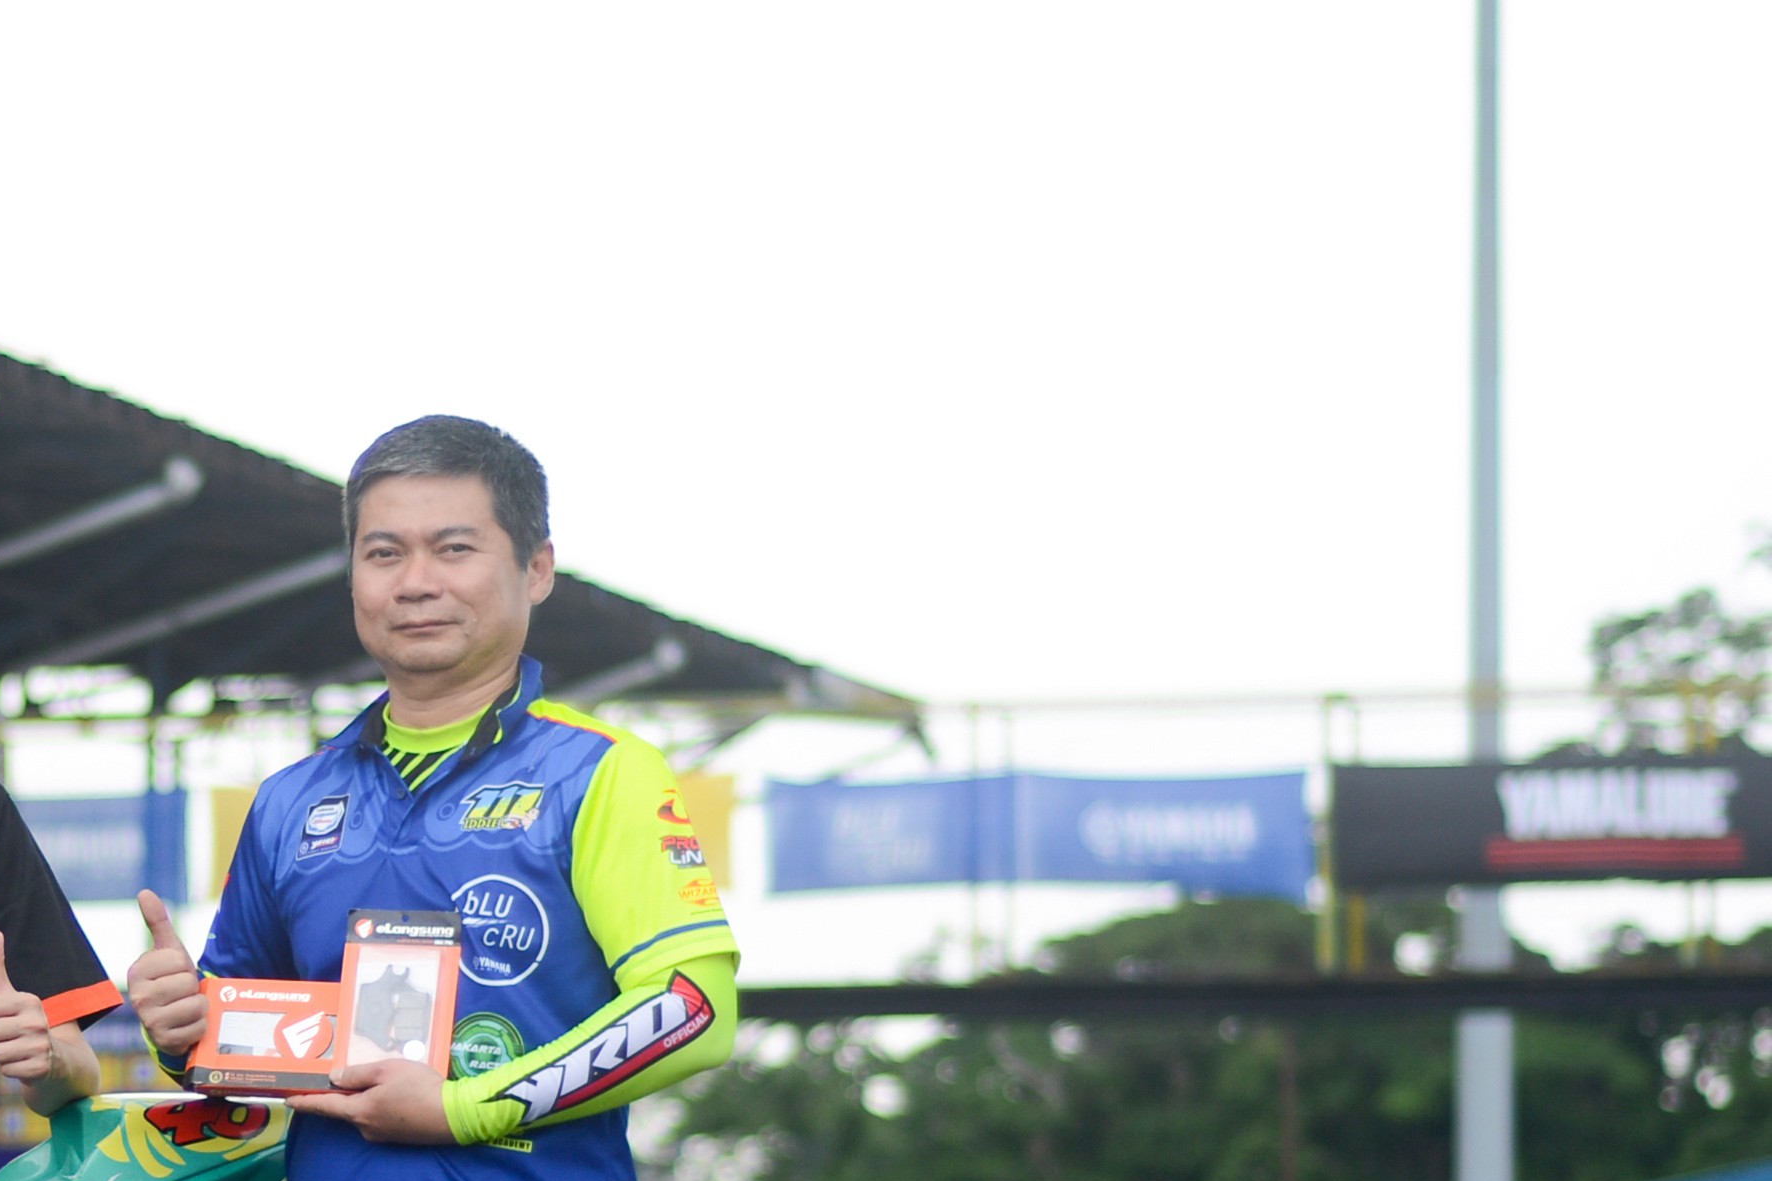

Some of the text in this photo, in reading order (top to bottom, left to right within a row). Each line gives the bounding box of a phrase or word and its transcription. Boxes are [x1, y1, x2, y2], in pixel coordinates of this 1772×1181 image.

[376, 923, 455, 938] eLangsung
[239, 990, 311, 1002] eLangsung
[663, 1012, 709, 1049] OFFICIAL
[144, 1099, 271, 1146] 40
